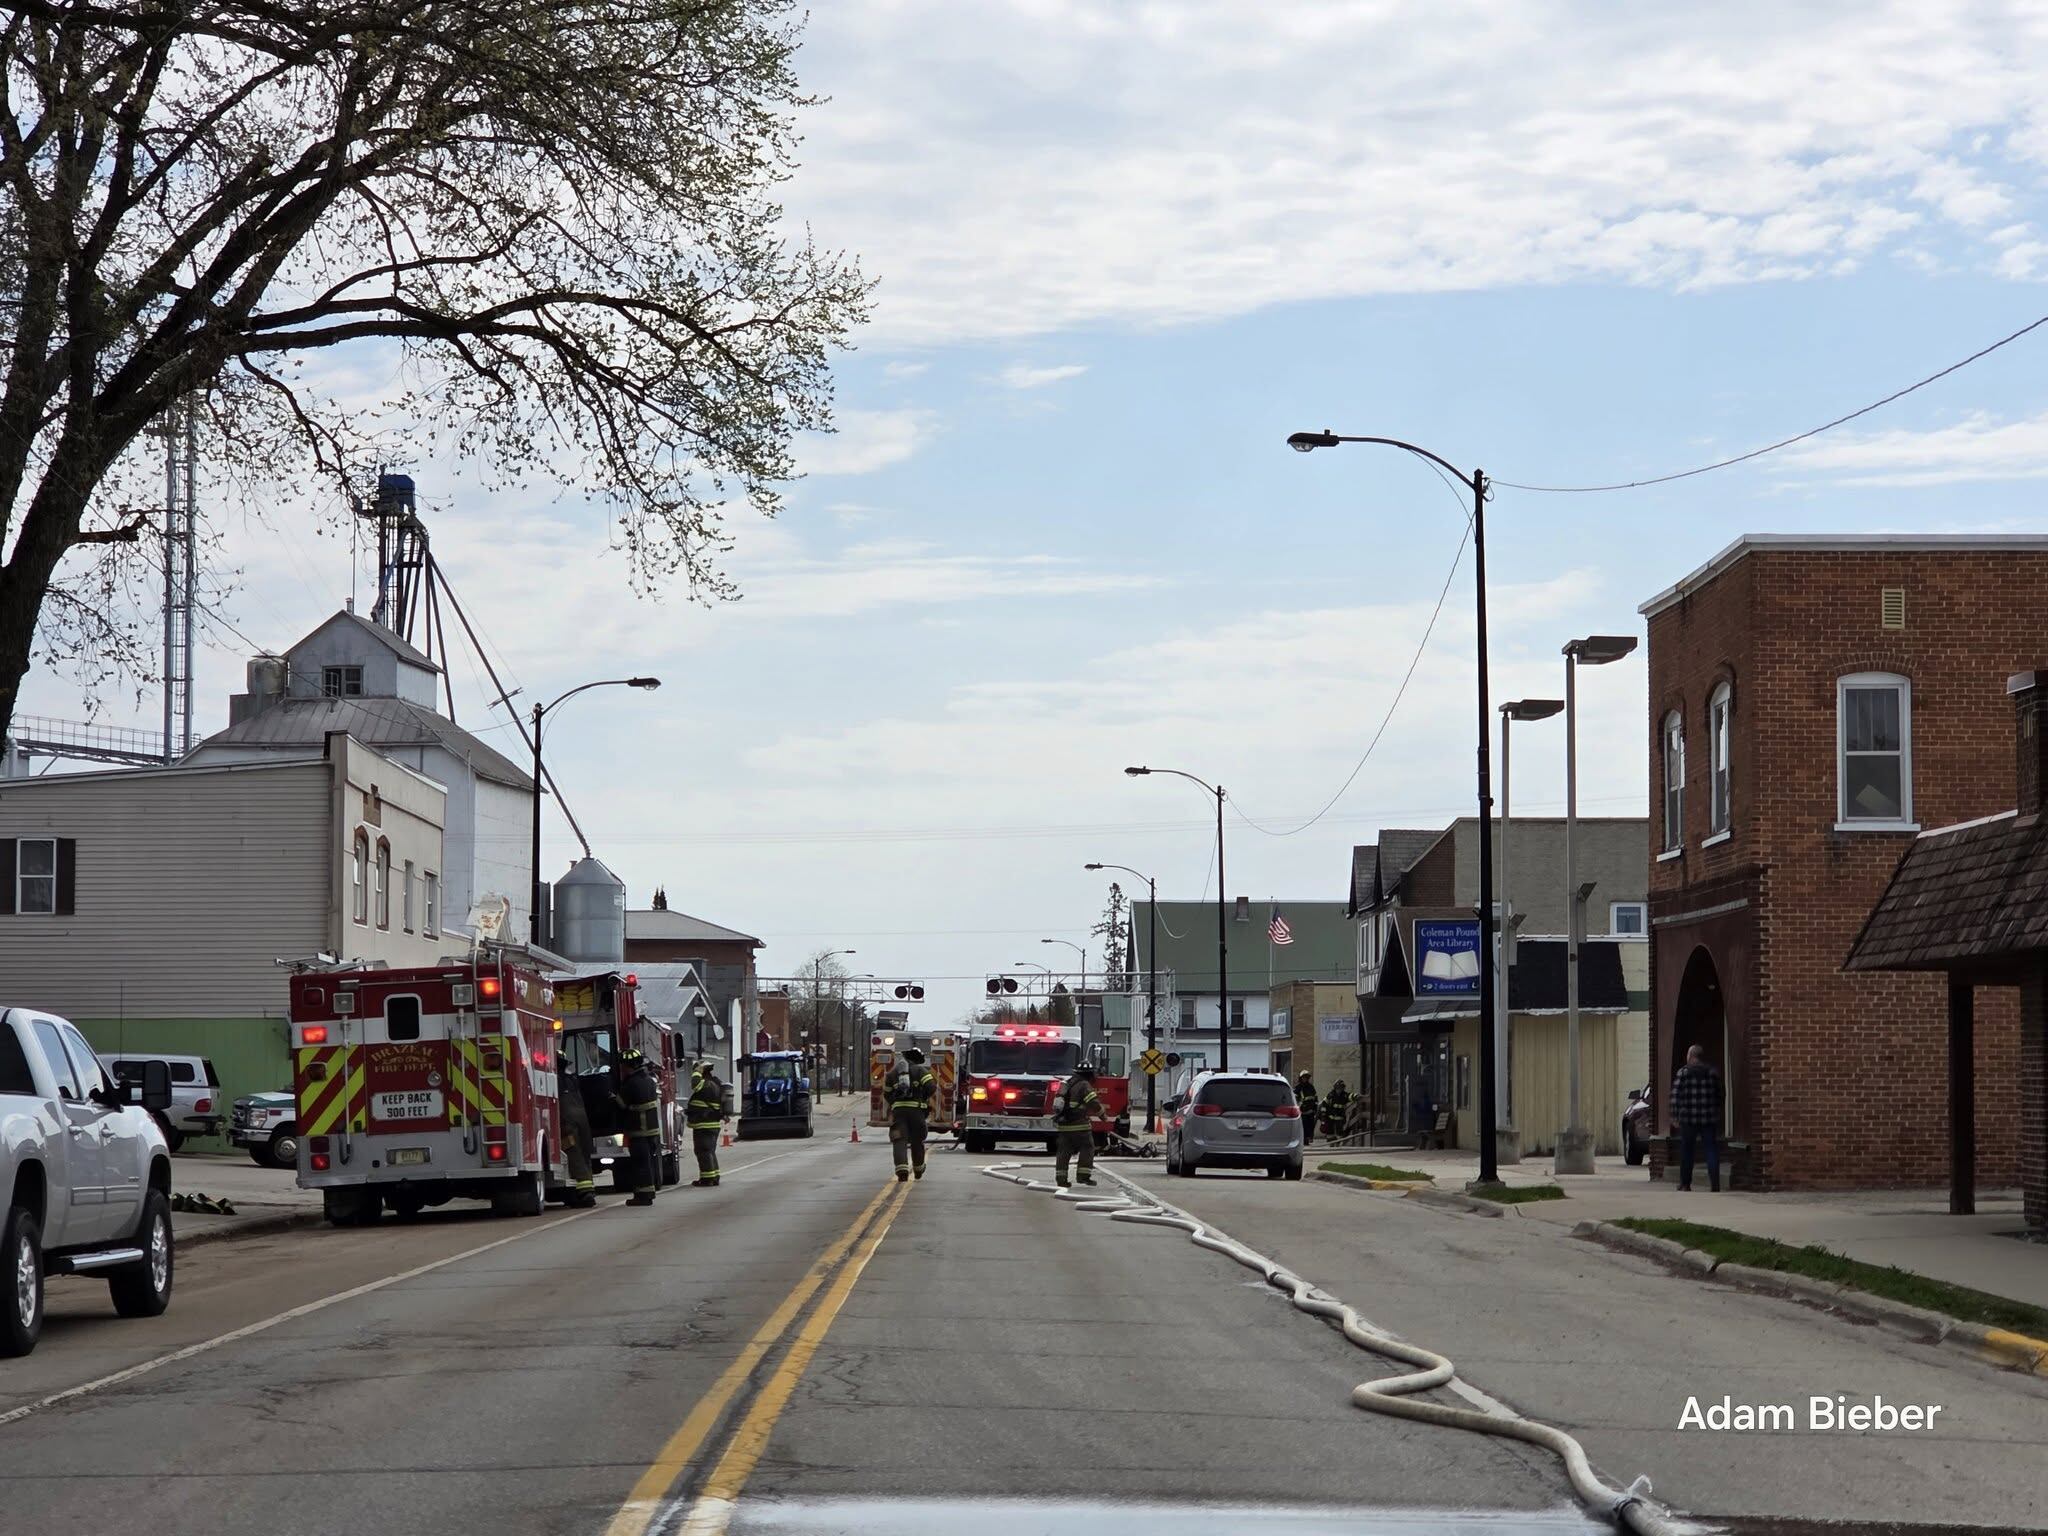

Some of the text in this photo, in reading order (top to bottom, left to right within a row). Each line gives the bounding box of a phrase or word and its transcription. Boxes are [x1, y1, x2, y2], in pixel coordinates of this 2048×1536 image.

[1421, 927, 1481, 937] Coleman Pound
[1427, 938, 1474, 950] Area Library
[374, 1064, 400, 1073] FIRE
[382, 1092, 432, 1105] KEEP BACK
[407, 1105, 429, 1117] FEET
